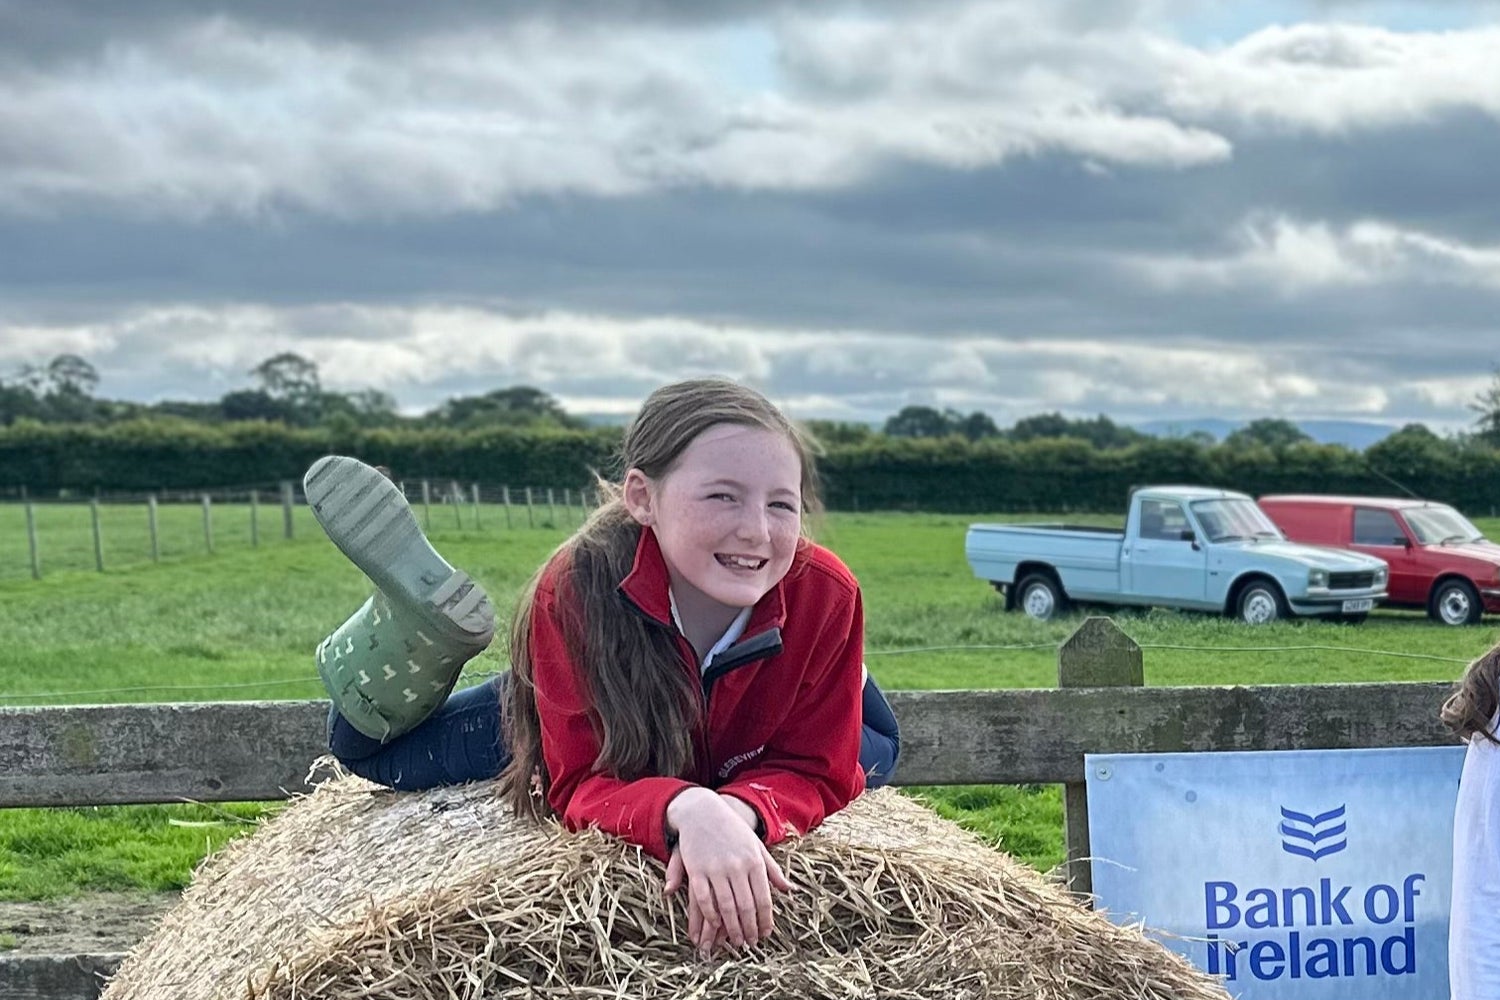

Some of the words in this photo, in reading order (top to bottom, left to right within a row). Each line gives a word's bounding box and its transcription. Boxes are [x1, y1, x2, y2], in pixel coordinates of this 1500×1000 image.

[1204, 878, 1354, 929] Bank
[1364, 873, 1426, 924] of
[1206, 926, 1416, 981] Ireland
